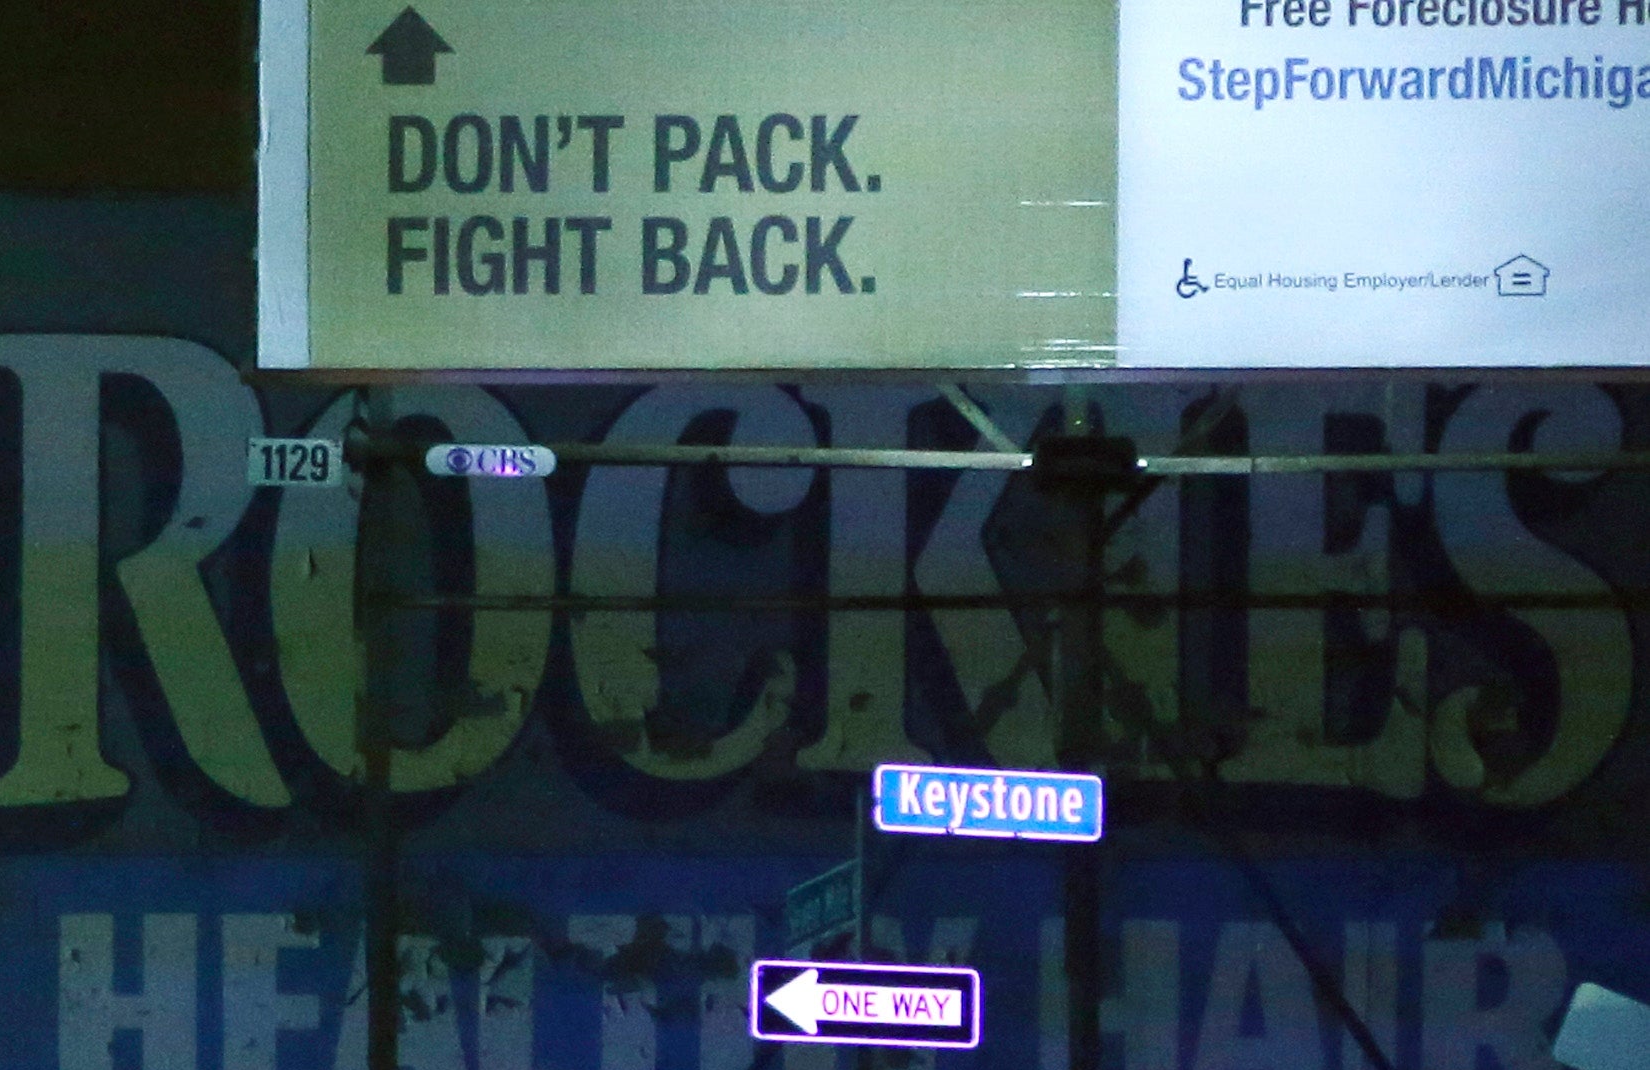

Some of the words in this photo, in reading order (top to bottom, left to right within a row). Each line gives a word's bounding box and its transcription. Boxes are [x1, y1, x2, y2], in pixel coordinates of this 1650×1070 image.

[1240, 0, 1331, 27] Free
[1348, 0, 1600, 27] Foreclosure
[1618, 0, 1650, 27] H
[387, 114, 624, 193] DON'T
[653, 114, 882, 193] PACK.
[386, 216, 612, 295] FIGHT
[642, 216, 876, 295] BACK.
[1215, 273, 1263, 290] Equal
[1268, 273, 1338, 291] Housing
[261, 445, 329, 482] 1129
[478, 448, 537, 474] CBS
[899, 773, 1083, 826] Keystone
[822, 988, 878, 1017] ONE
[891, 991, 952, 1020] WAY
